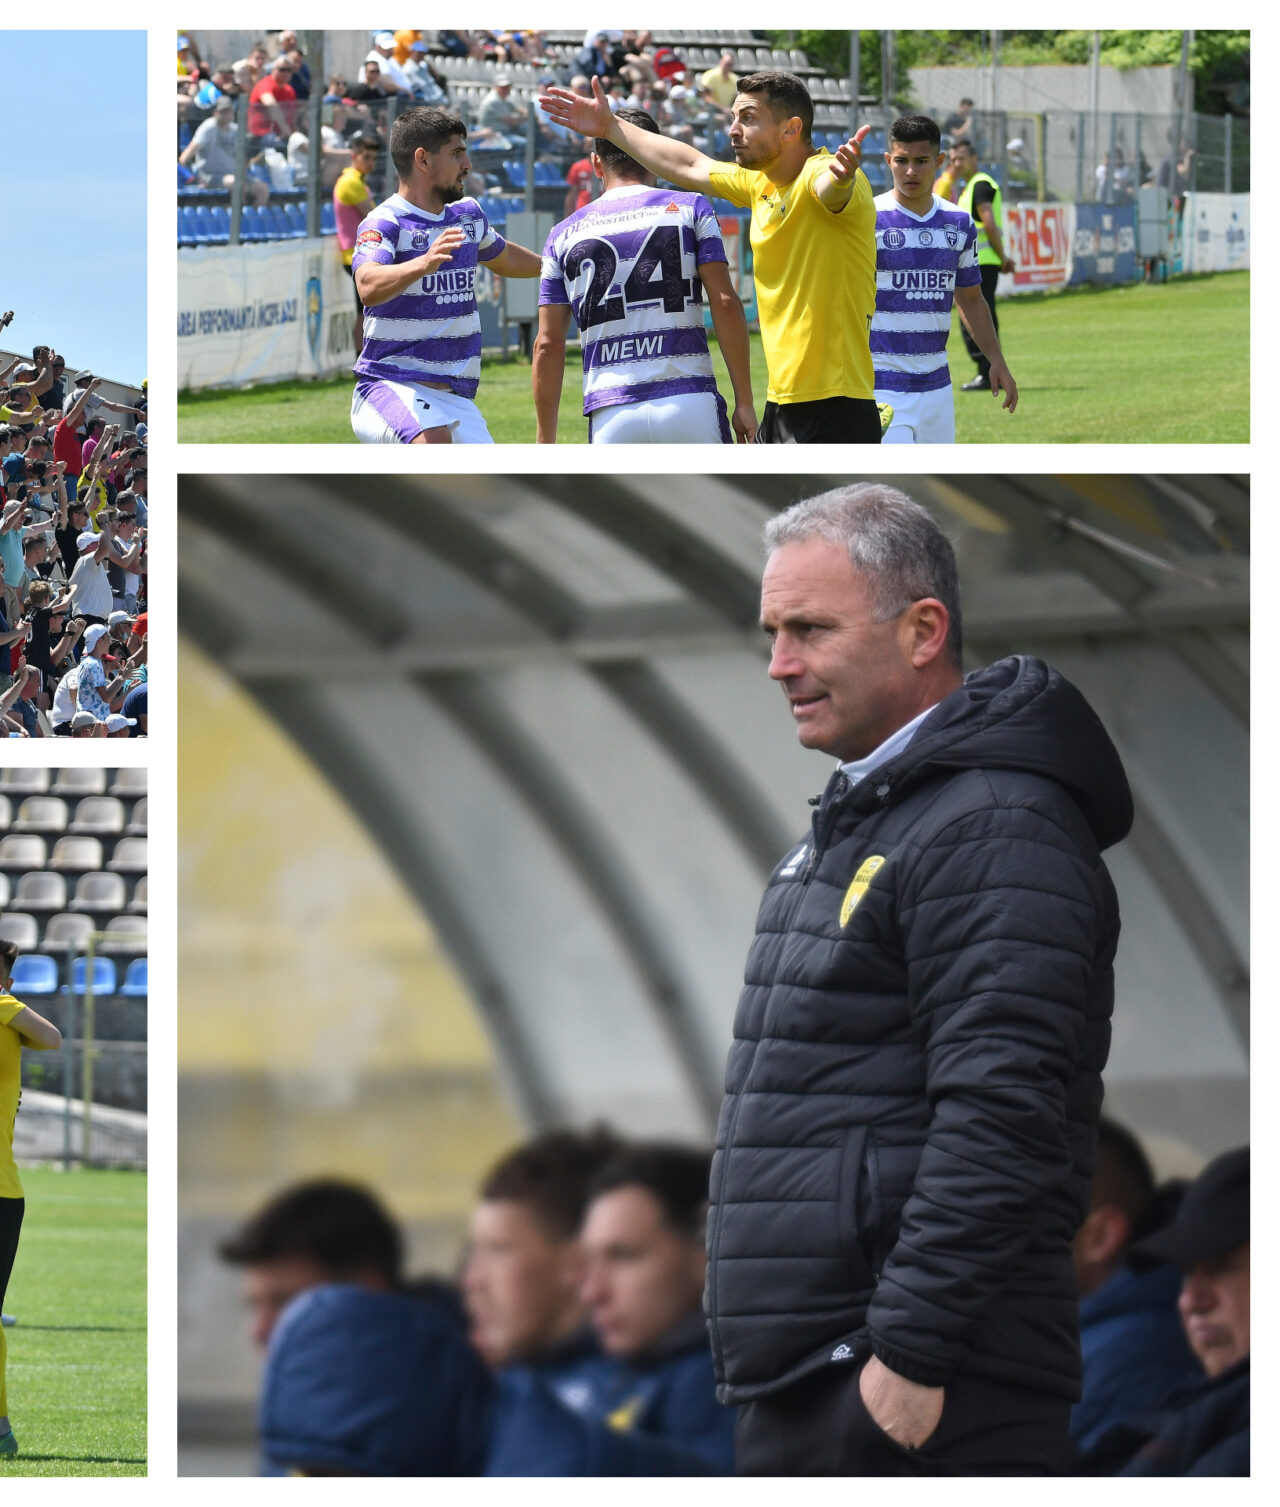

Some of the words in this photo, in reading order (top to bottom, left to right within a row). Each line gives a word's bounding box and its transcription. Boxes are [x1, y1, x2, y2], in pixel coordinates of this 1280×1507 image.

[421, 270, 476, 293] UNIBE
[564, 225, 692, 332] 24
[892, 272, 953, 289] UNIBET
[600, 335, 664, 363] MEWI
